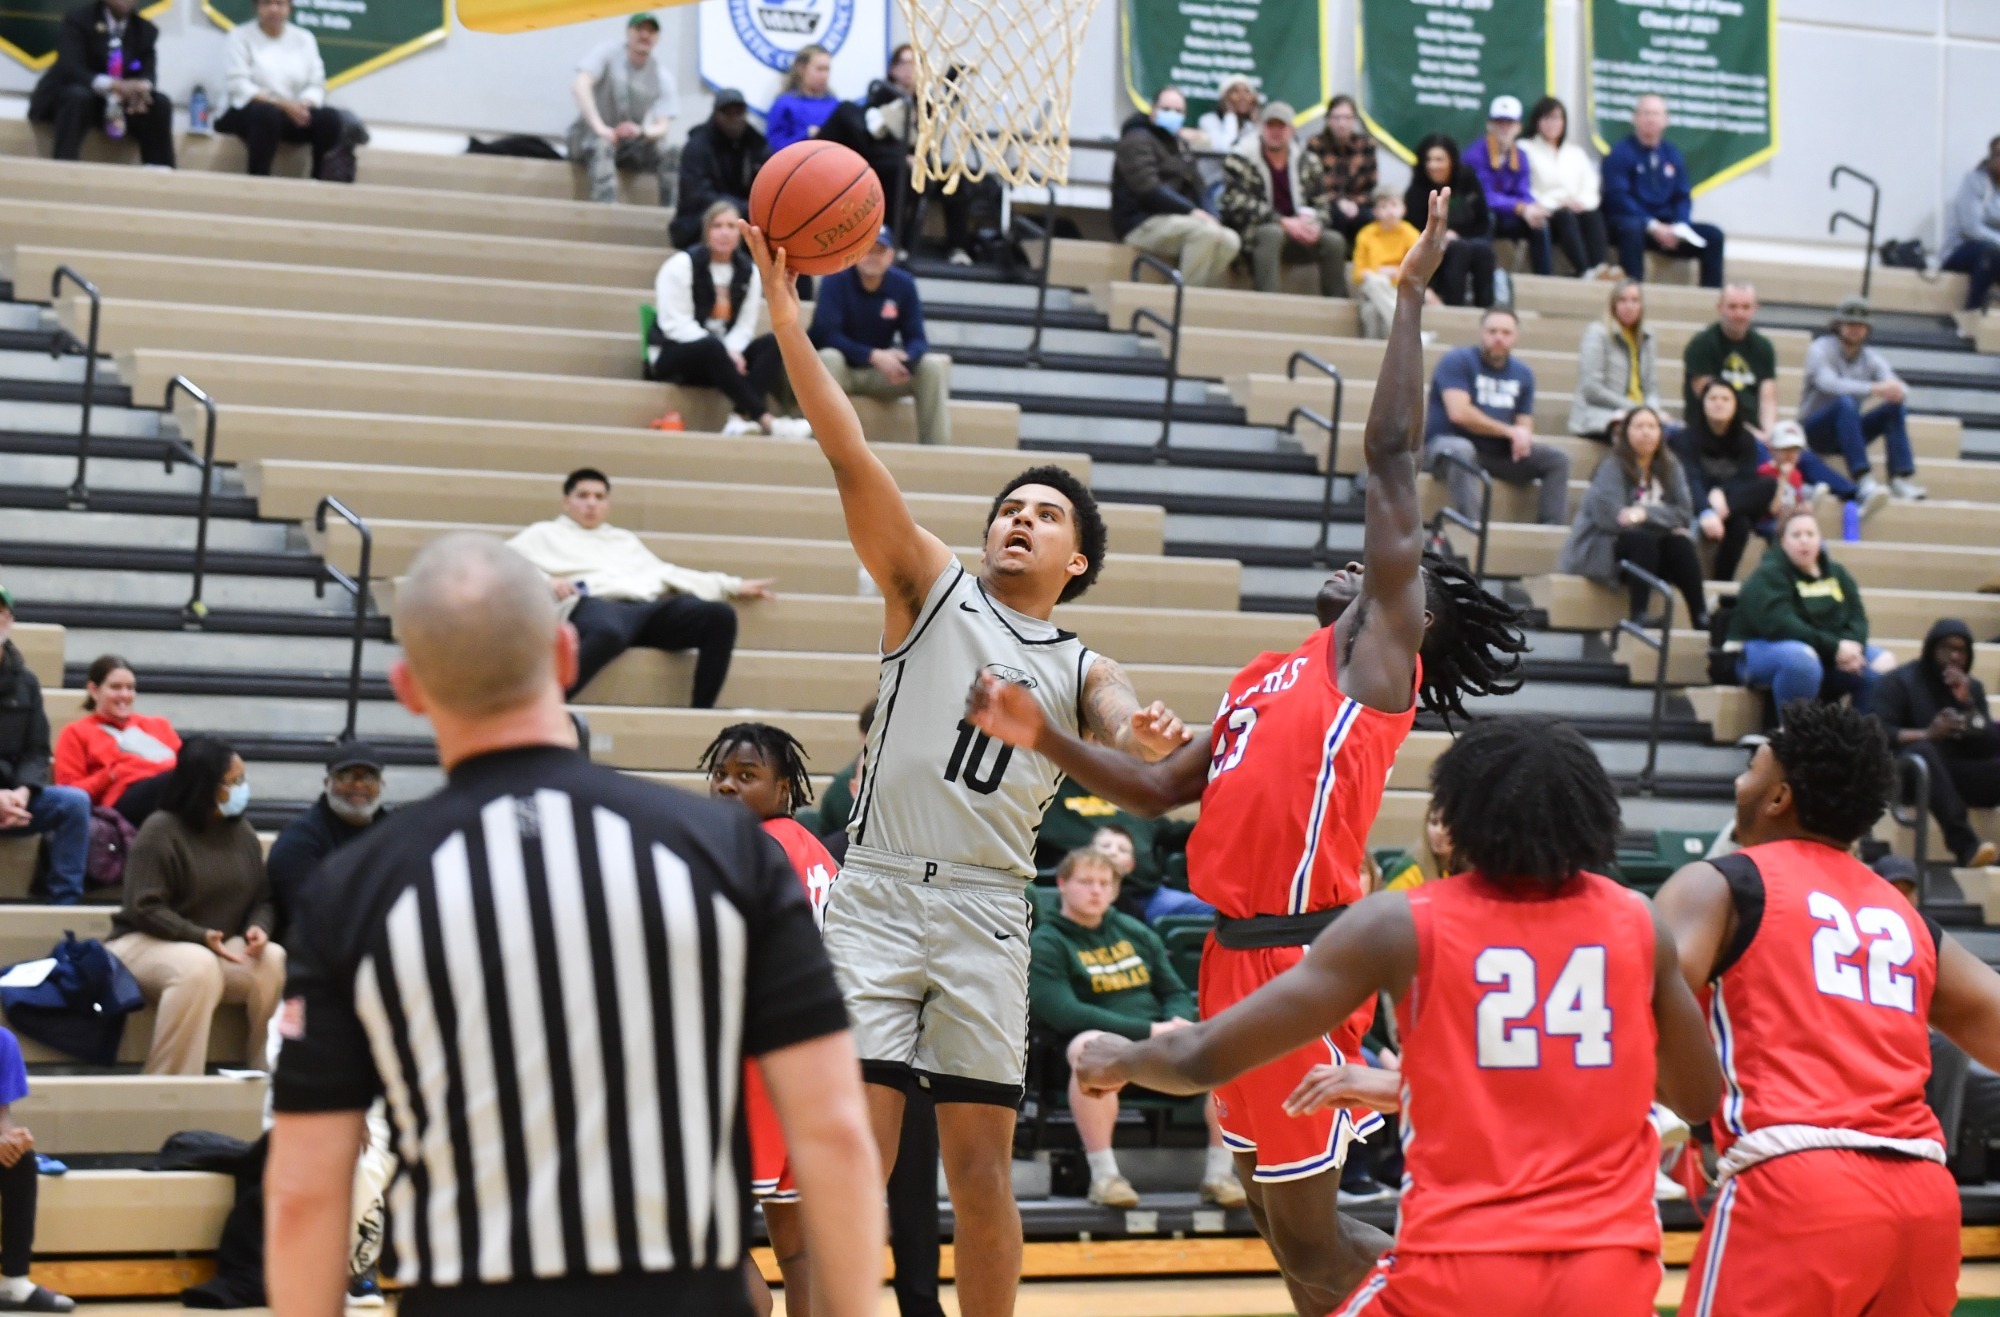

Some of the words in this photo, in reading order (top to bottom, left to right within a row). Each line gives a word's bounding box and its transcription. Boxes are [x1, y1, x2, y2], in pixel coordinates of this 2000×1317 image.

[813, 183, 882, 253] SPALDING
[944, 717, 1015, 796] 10
[922, 861, 938, 883] P
[1806, 889, 1917, 1015] 22
[1474, 944, 1613, 1070] 24
